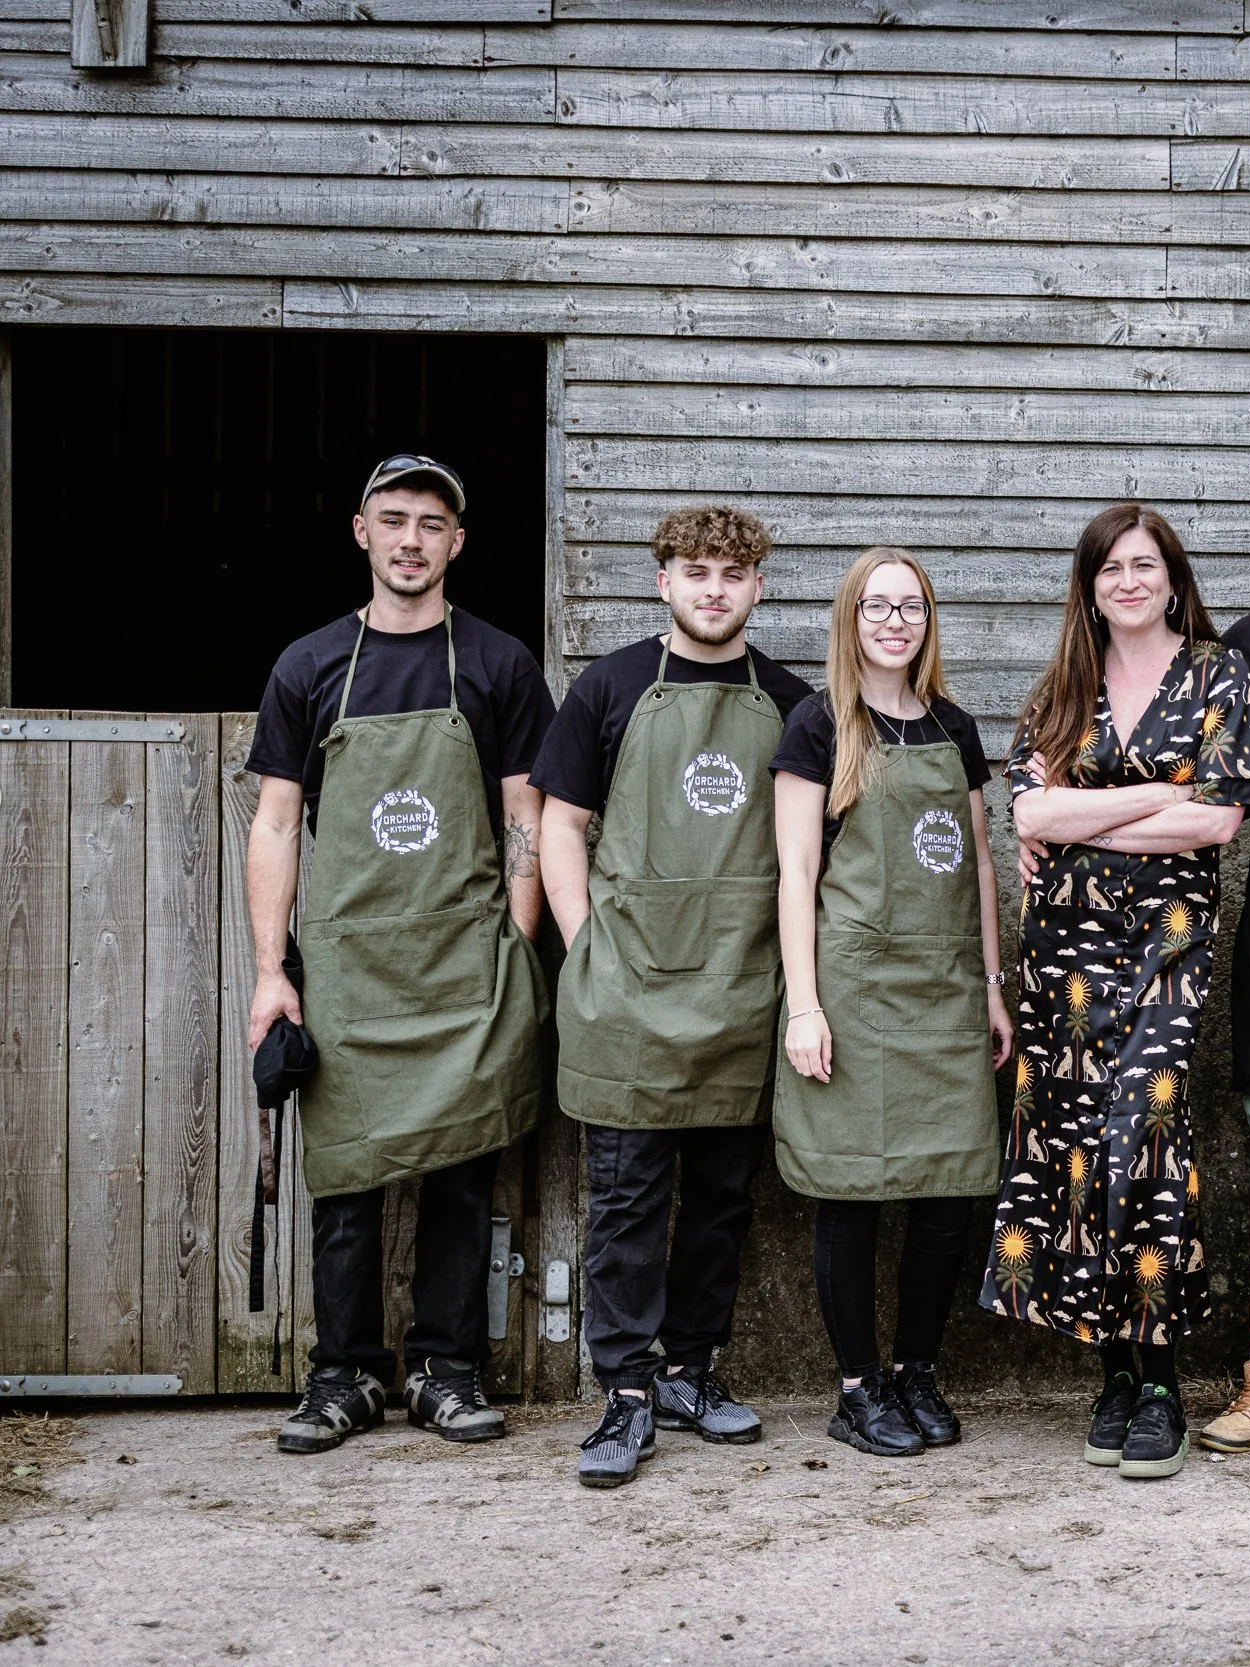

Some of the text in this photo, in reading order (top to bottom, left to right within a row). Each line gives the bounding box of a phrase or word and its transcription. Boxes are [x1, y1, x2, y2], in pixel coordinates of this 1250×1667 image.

[694, 776, 736, 786] ORCHARD
[383, 812, 428, 824] ORCHARD
[922, 834, 956, 844] ORCHARD
